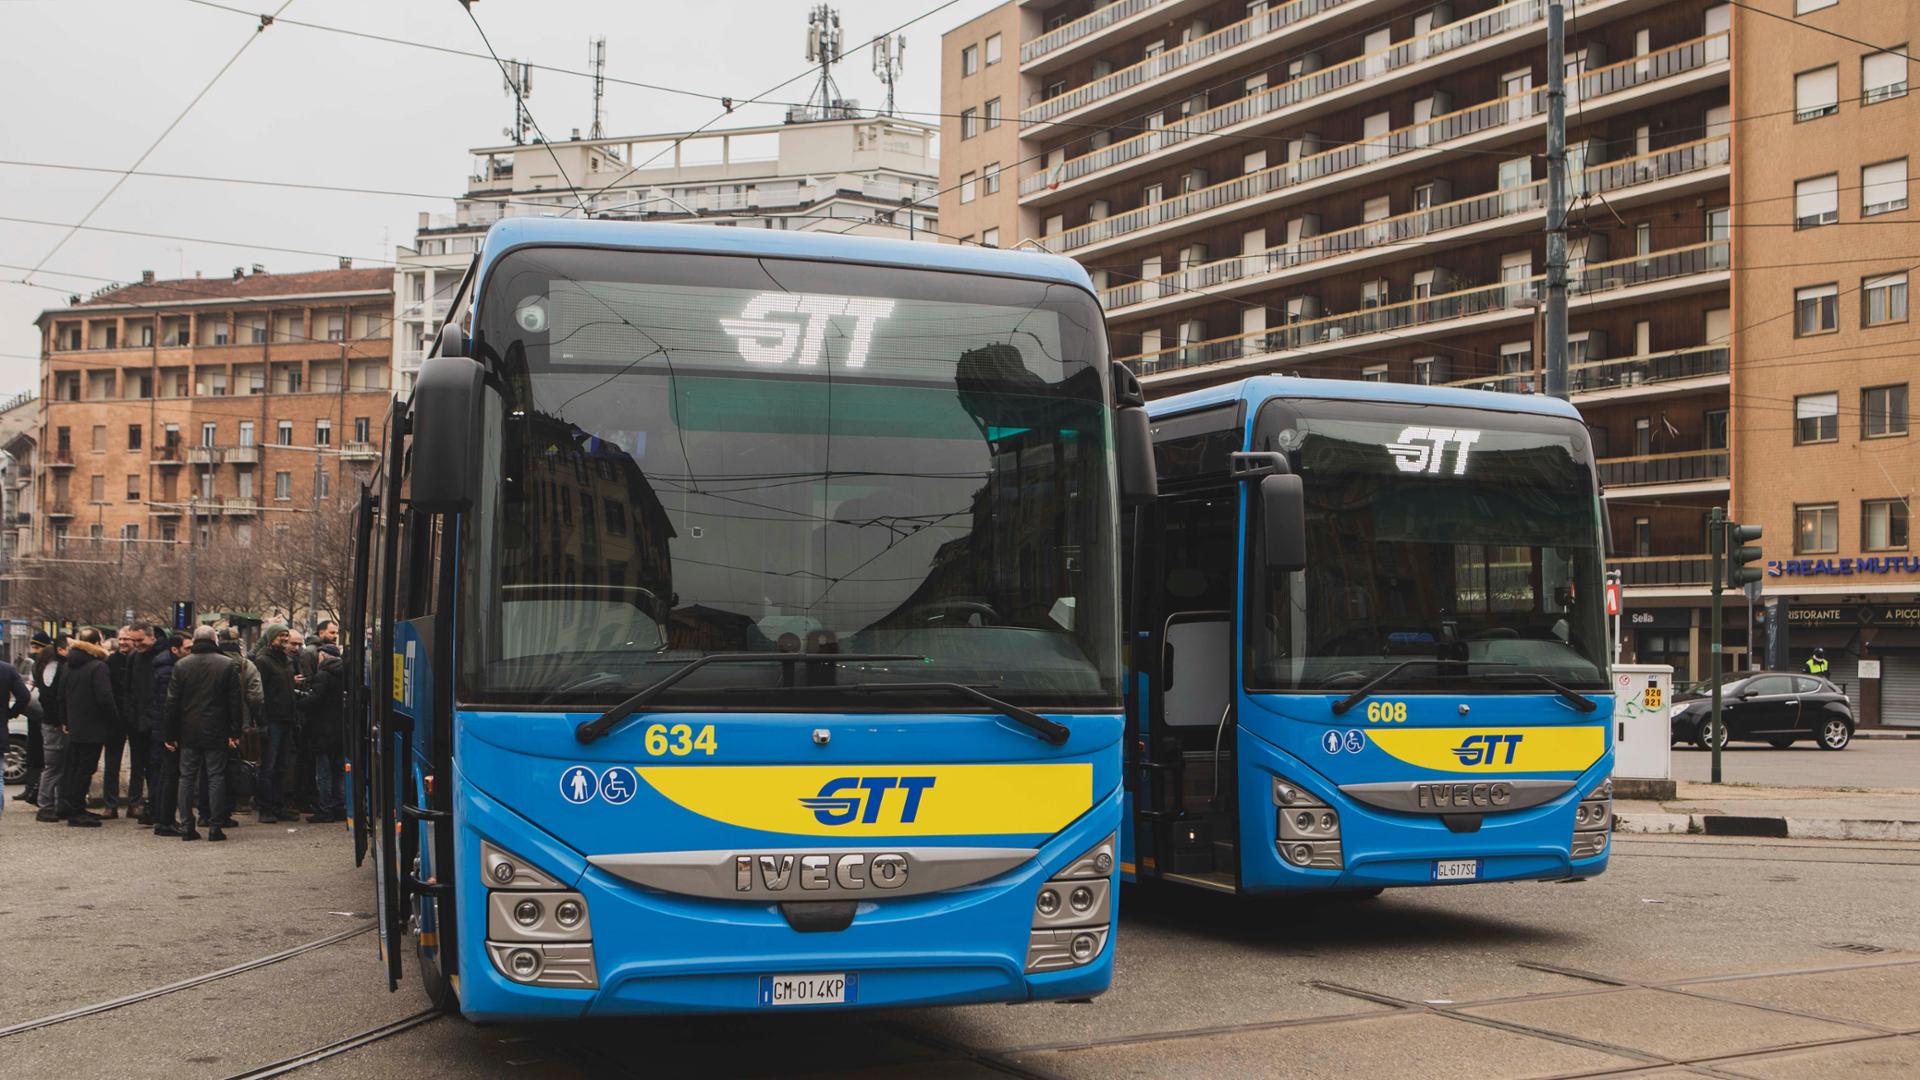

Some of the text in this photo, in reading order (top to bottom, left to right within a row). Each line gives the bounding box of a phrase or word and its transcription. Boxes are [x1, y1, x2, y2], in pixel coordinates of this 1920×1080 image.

[720, 293, 895, 367] GTT
[1385, 426, 1480, 475] GTT
[1786, 556, 1920, 575] REALE MUTU
[1632, 612, 1654, 623] Sella
[1886, 610, 1893, 619] A
[1367, 702, 1407, 723] 608
[644, 724, 717, 756] 634
[1451, 735, 1523, 766] GTT
[798, 776, 936, 826] GTT
[1419, 783, 1511, 808] IVECO
[735, 853, 908, 892] IVECO
